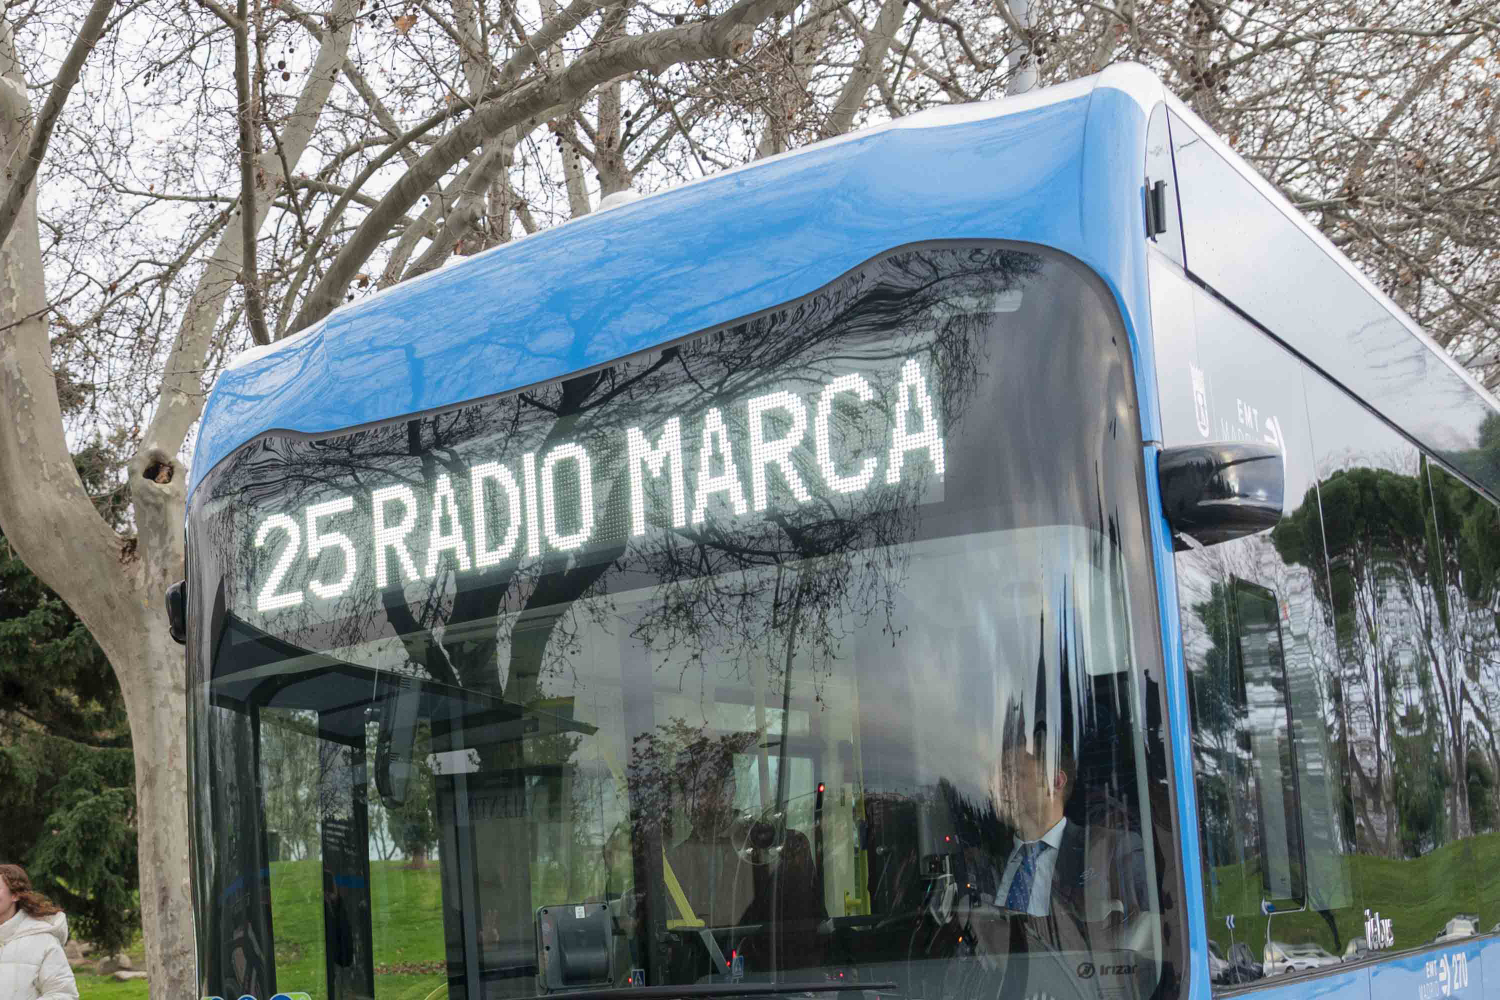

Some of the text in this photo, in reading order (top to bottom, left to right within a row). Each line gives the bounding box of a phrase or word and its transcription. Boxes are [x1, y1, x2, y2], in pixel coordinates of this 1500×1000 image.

[1236, 397, 1259, 433] EMT
[253, 359, 946, 613] 25 RADIO MARCA
[1452, 952, 1469, 990] 270
